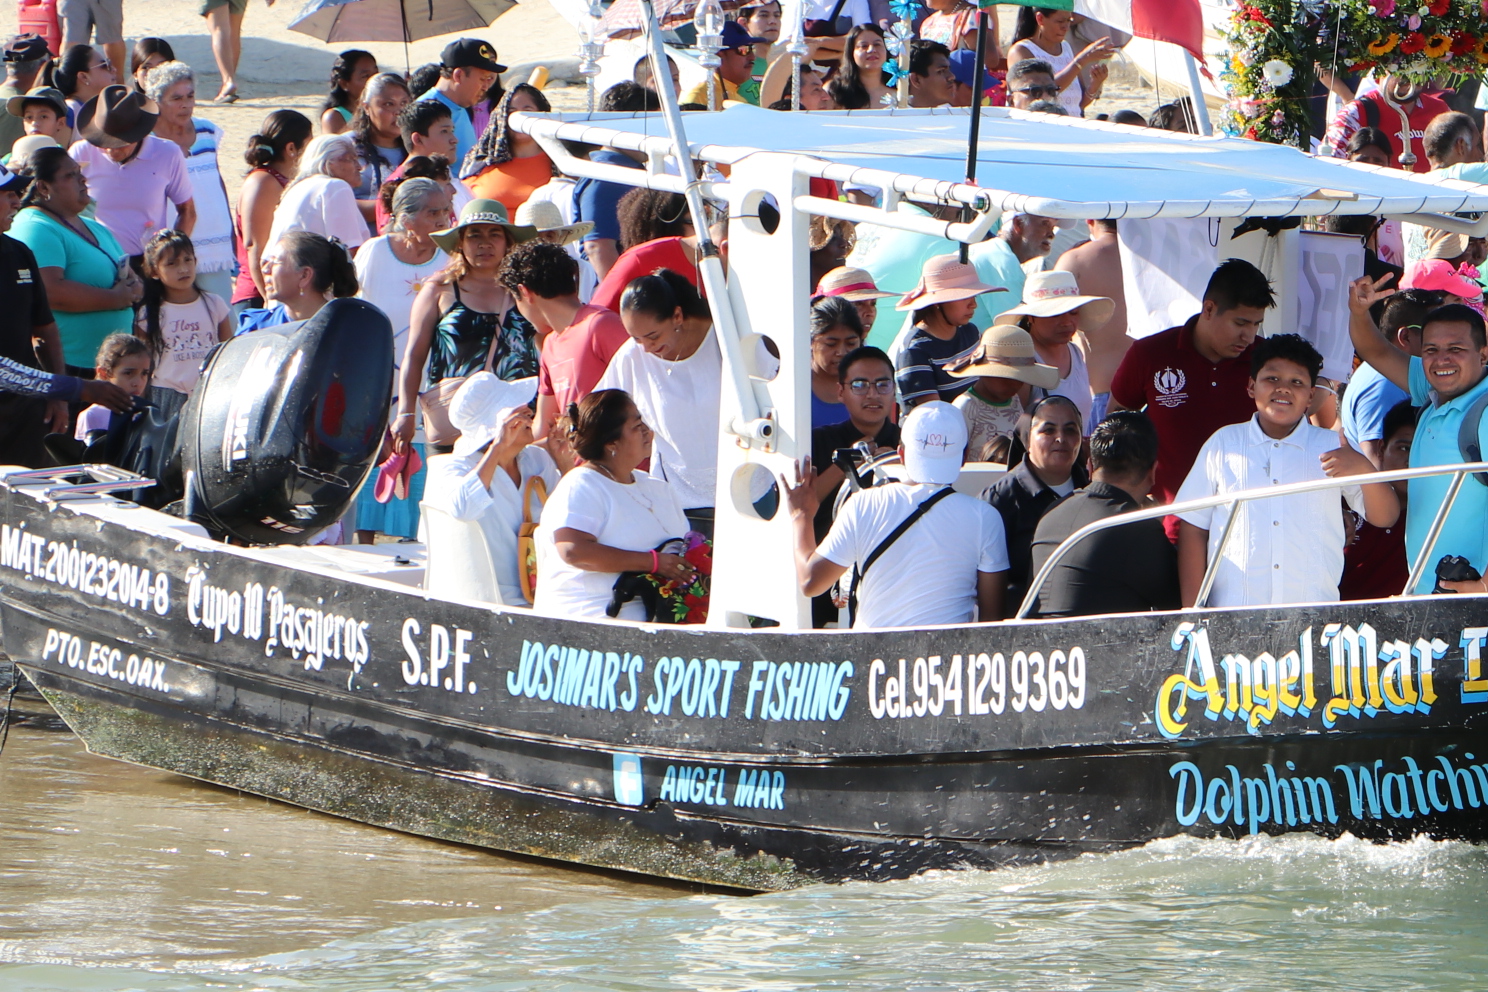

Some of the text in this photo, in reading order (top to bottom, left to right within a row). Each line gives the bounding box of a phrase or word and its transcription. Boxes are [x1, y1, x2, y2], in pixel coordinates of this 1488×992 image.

[401, 618, 477, 695] S.P.F.
[507, 639, 854, 722] JOSIMAR'S SPORT FISHING
[1155, 621, 1319, 740] Angel
[1320, 622, 1450, 729] Mar
[660, 764, 728, 807] ANGEL
[733, 768, 786, 810] MAR
[1168, 758, 1340, 836] Dolphin
